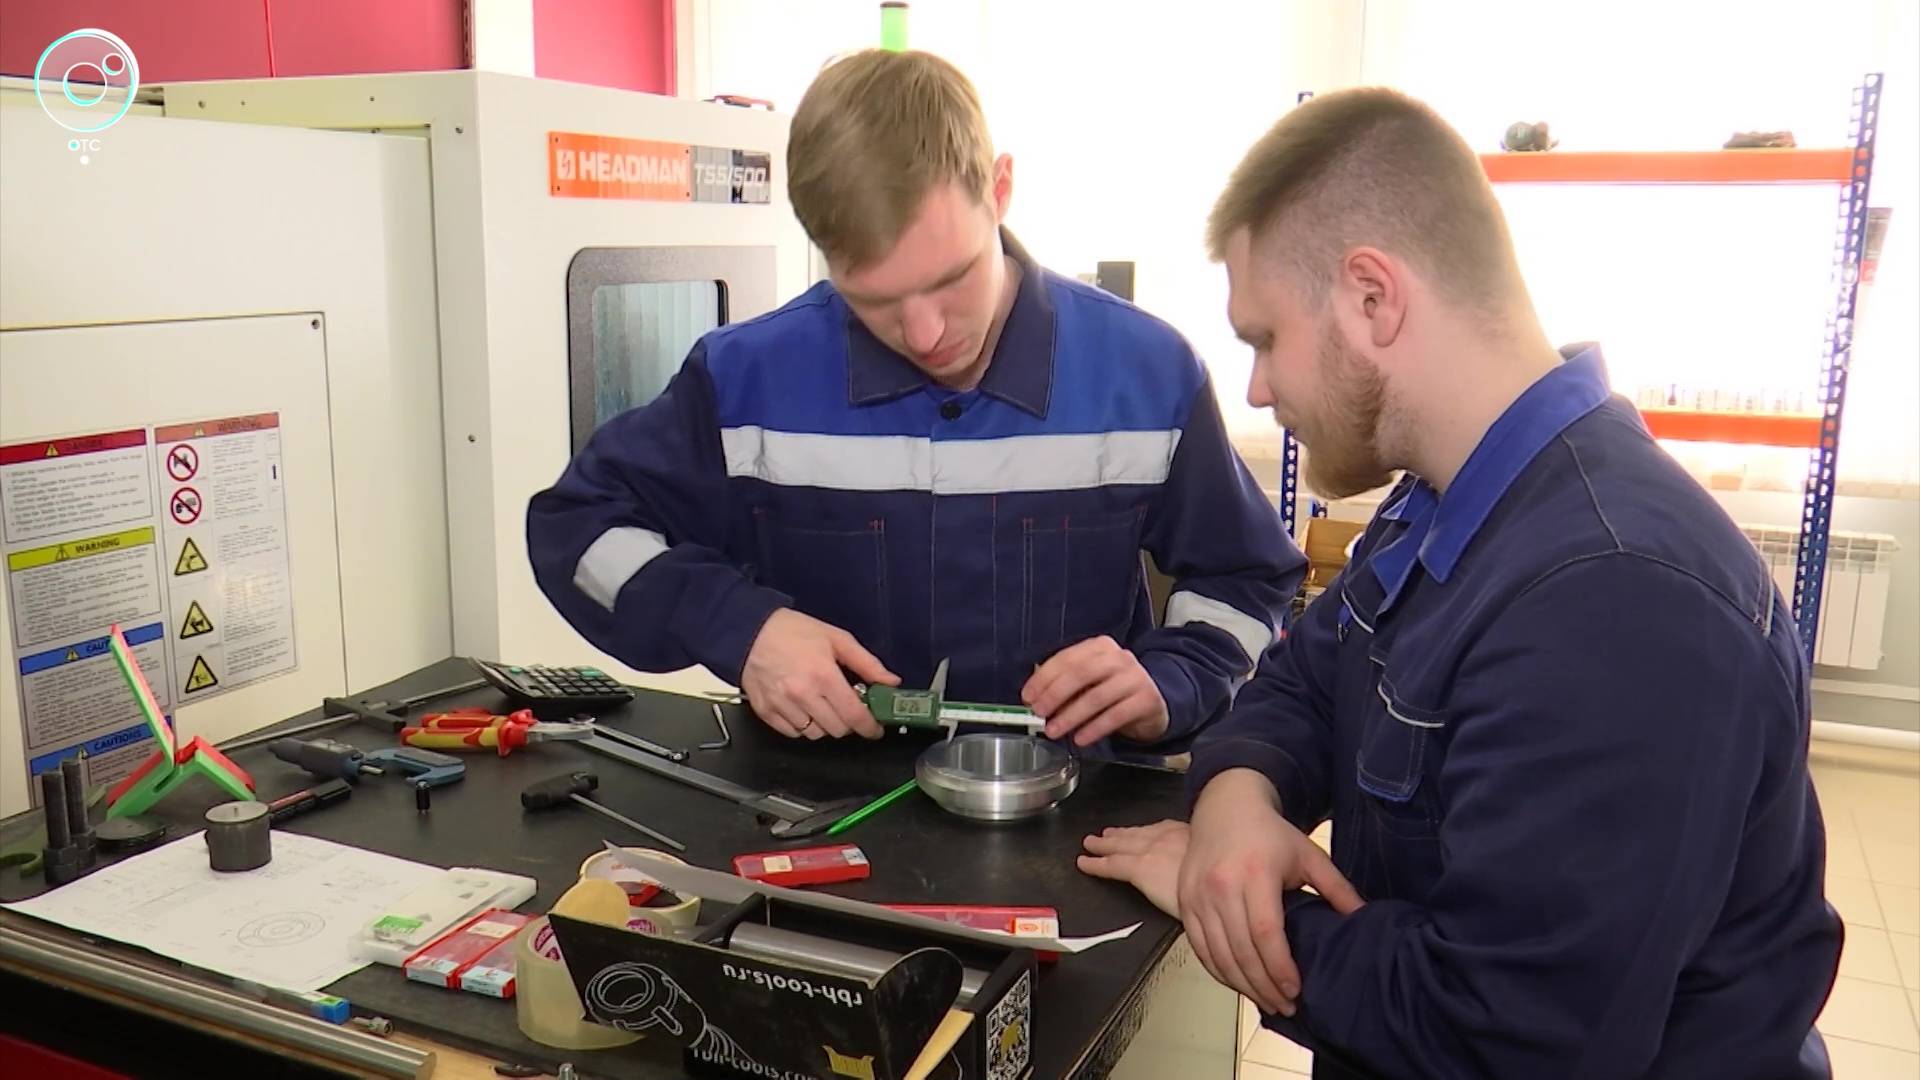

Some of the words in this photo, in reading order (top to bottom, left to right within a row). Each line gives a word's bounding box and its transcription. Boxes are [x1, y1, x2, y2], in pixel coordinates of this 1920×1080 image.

[579, 151, 687, 186] HEADMAN
[75, 537, 121, 554] WARNING
[721, 963, 864, 1008] rbh-tools.ru
